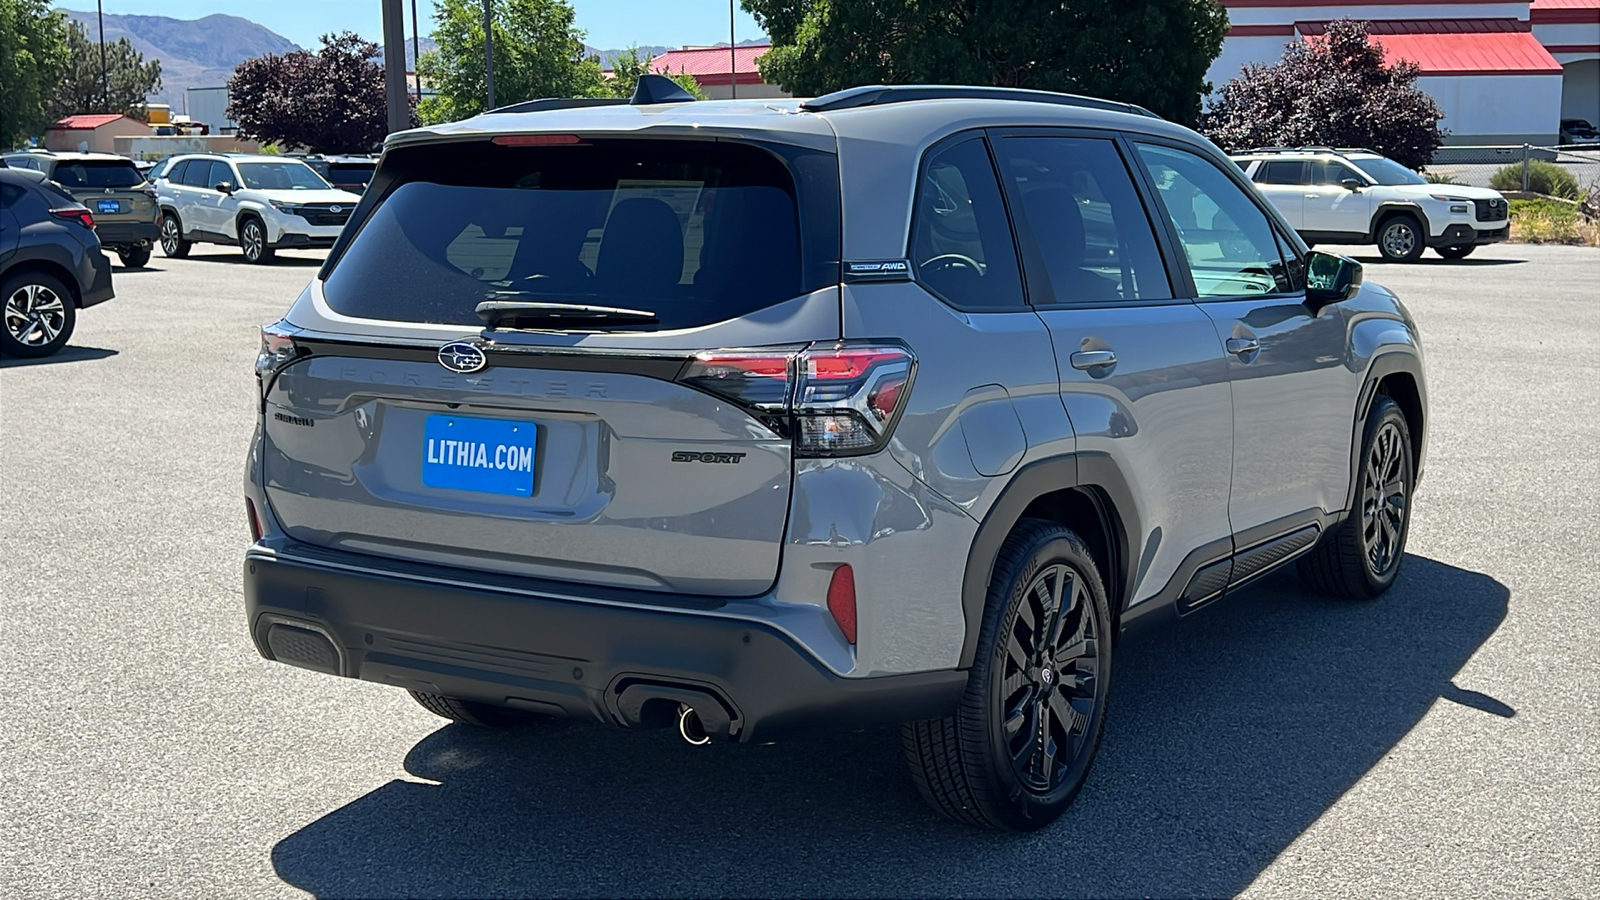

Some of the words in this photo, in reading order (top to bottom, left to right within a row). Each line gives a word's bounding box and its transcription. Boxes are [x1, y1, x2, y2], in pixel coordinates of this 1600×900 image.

[274, 412, 315, 428] SUBARU
[427, 438, 533, 473] LITHIA.COM
[671, 451, 747, 464] SPORT
[995, 558, 1038, 660] BRIDGESTONE
